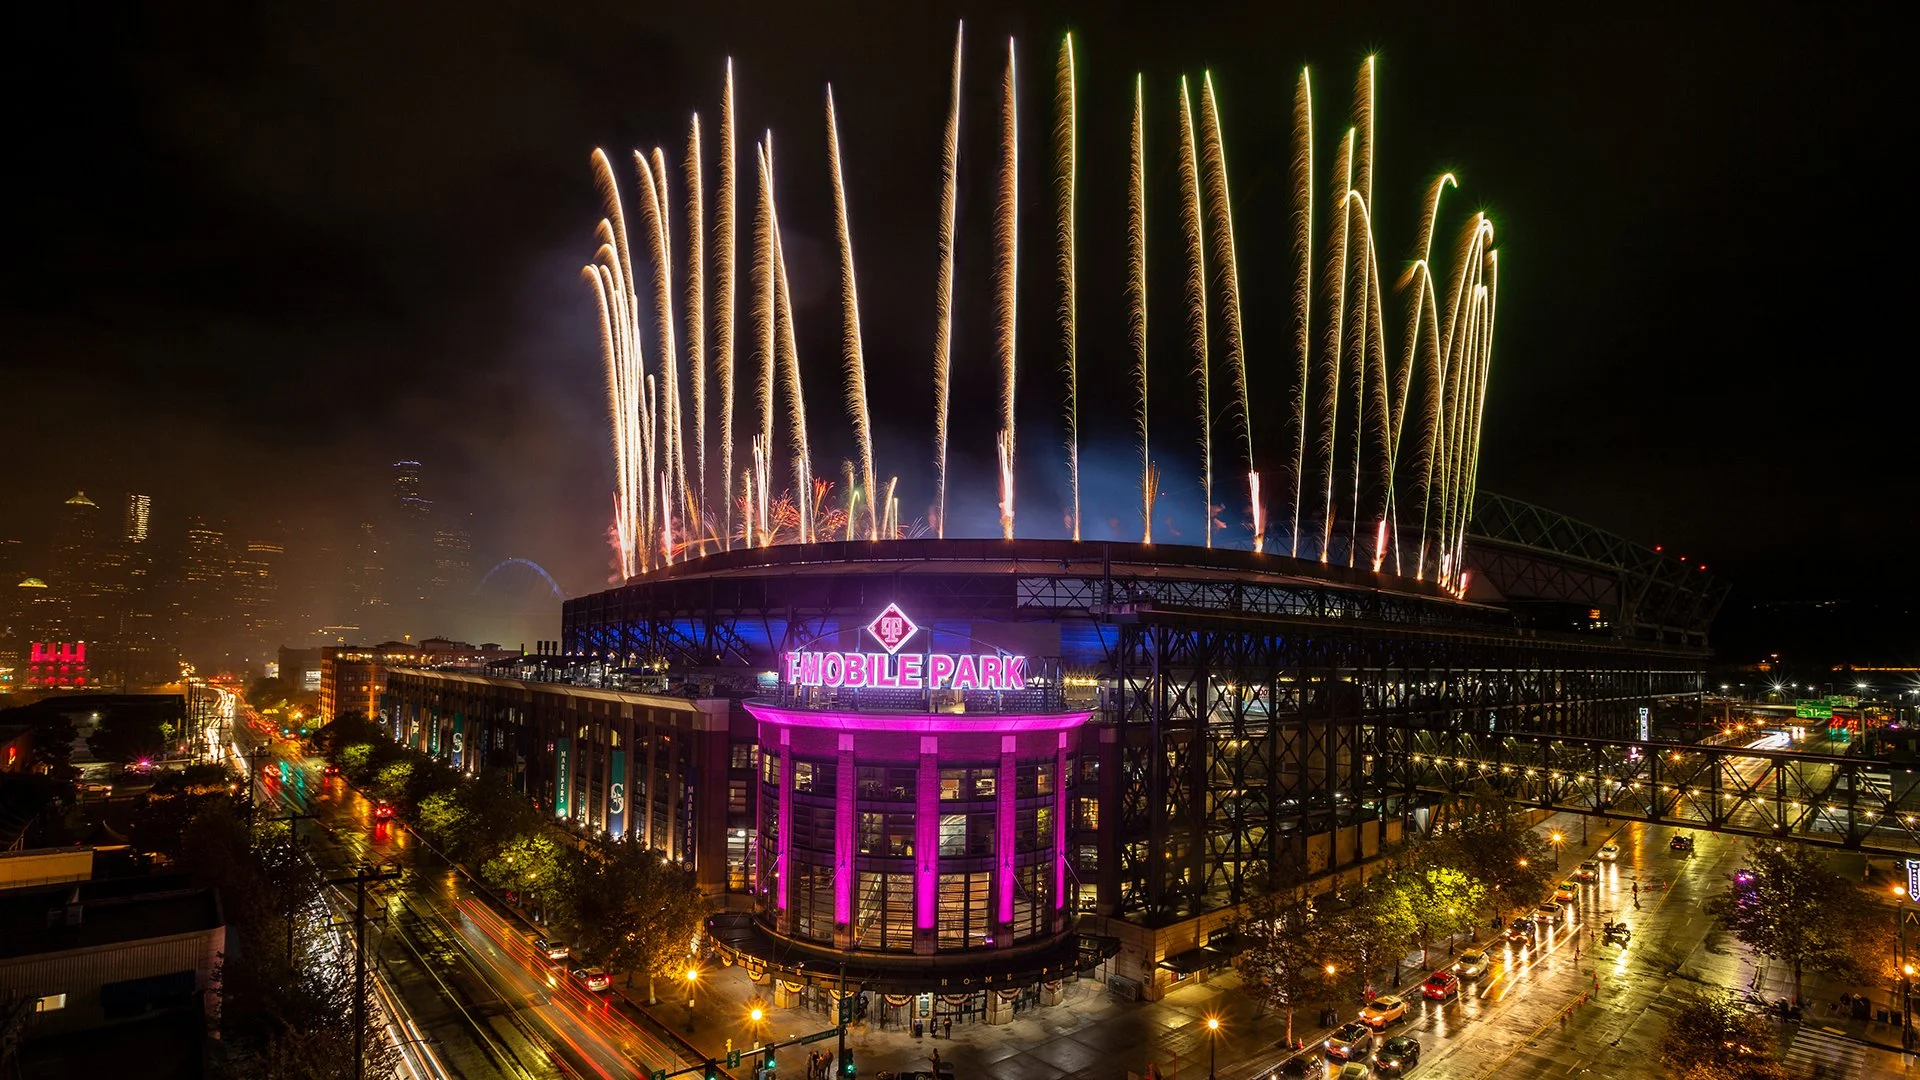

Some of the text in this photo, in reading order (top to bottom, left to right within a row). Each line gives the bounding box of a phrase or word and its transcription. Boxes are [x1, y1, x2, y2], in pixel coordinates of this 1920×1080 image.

[784, 651, 1026, 690] T-MOBILE PARK
[686, 785, 694, 855] MARINERS
[941, 950, 1103, 986] HOME PLATE
